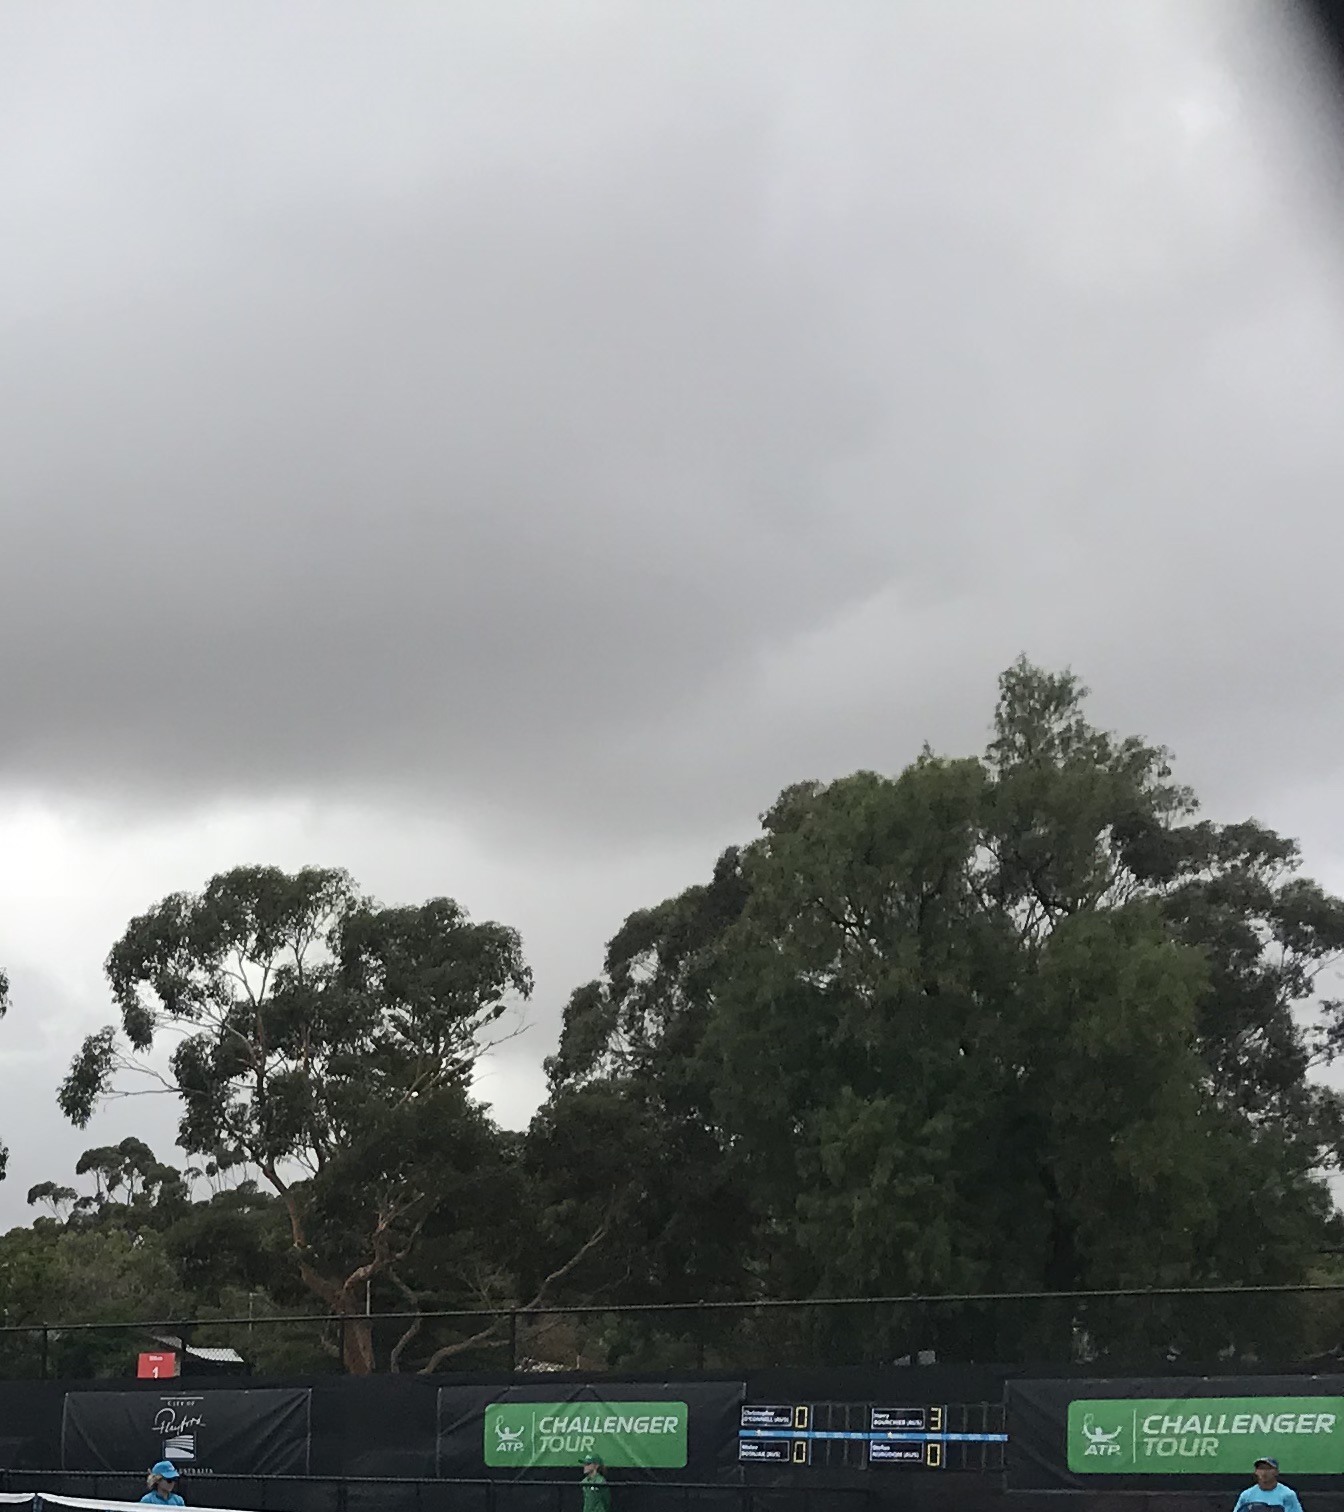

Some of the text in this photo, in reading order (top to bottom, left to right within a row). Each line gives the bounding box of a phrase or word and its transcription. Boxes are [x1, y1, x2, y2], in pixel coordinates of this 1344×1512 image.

[539, 1416, 679, 1434] CHALLENGER
[795, 1406, 808, 1428] 0
[930, 1407, 941, 1430] 3
[1142, 1413, 1336, 1434] CHALLENGER
[496, 1442, 524, 1452] ATP
[540, 1436, 596, 1453] TOUR
[793, 1441, 806, 1463] 0
[927, 1443, 941, 1466] 0
[1084, 1444, 1120, 1456] ATP
[1143, 1437, 1219, 1457] TOUR
